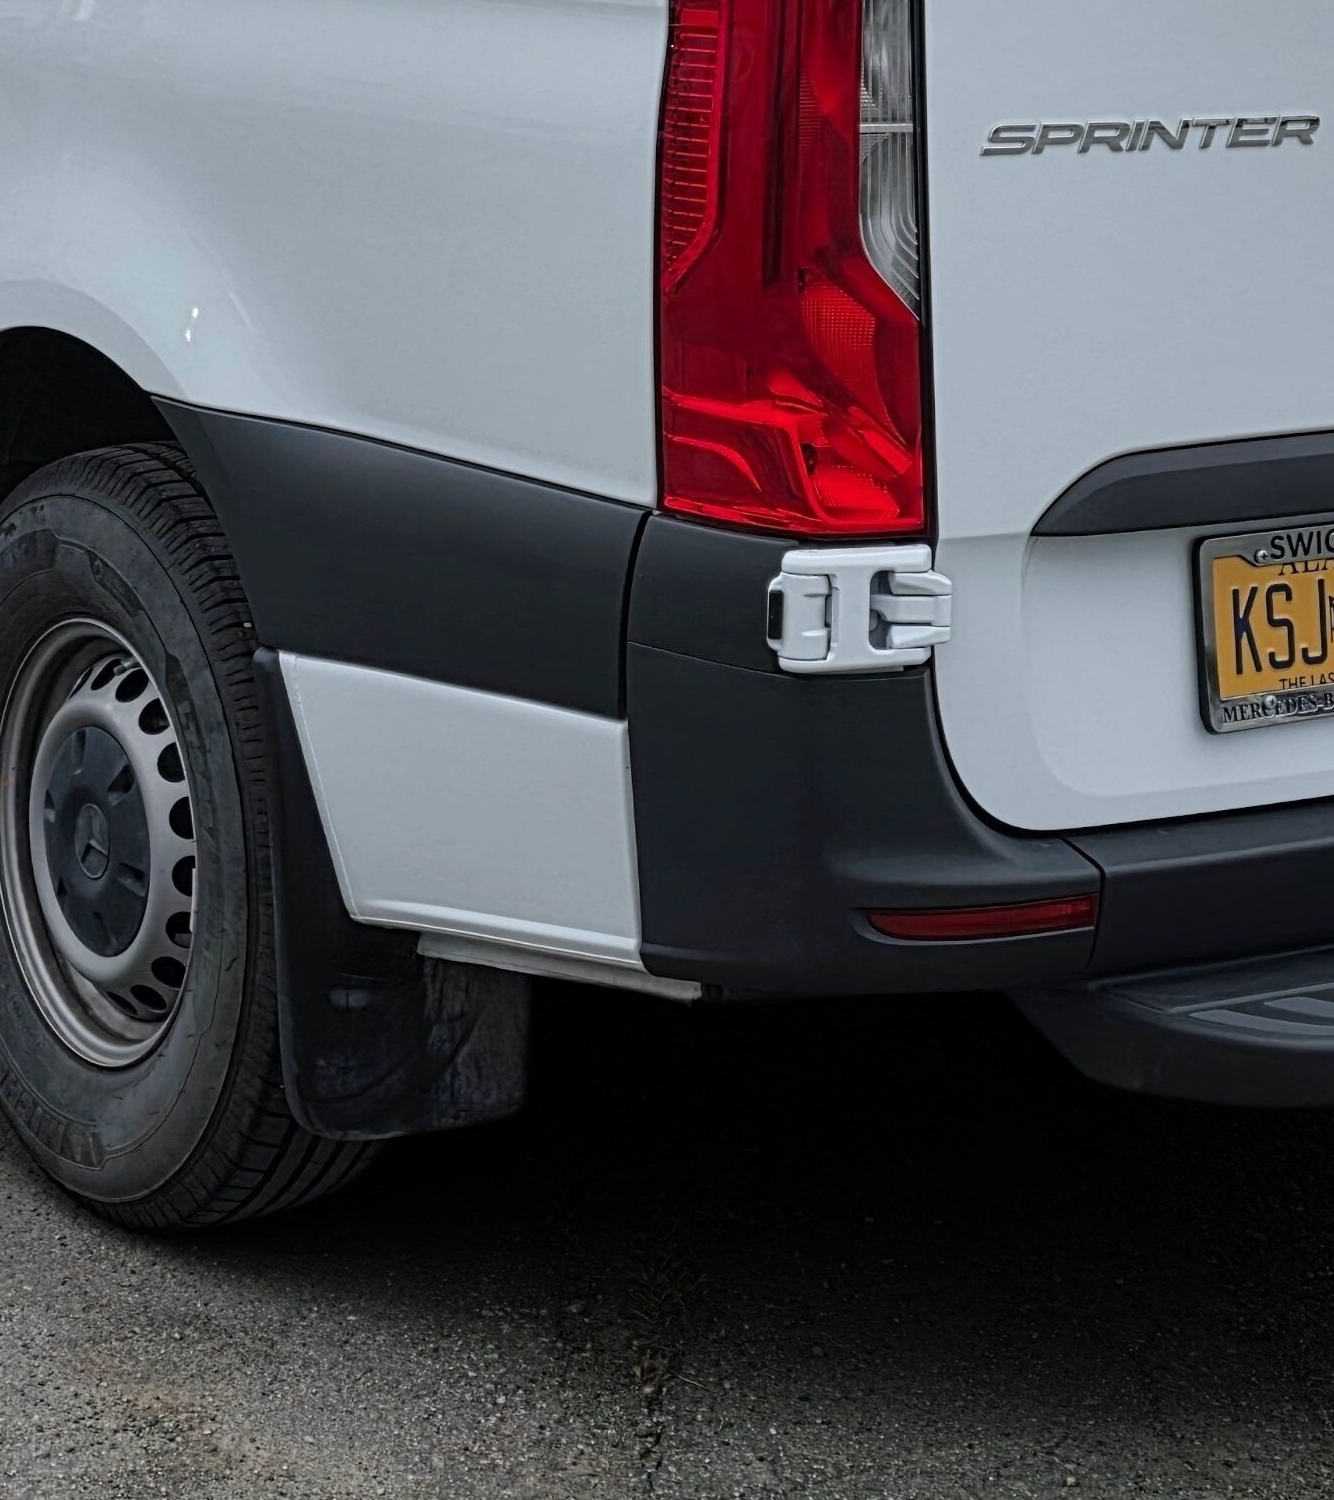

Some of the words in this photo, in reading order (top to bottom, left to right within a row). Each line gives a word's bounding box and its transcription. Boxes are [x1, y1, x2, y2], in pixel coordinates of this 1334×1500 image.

[980, 115, 1321, 156] SPRINTER
[1232, 578, 1328, 675] KSJ
[1279, 676, 1306, 690] THE
